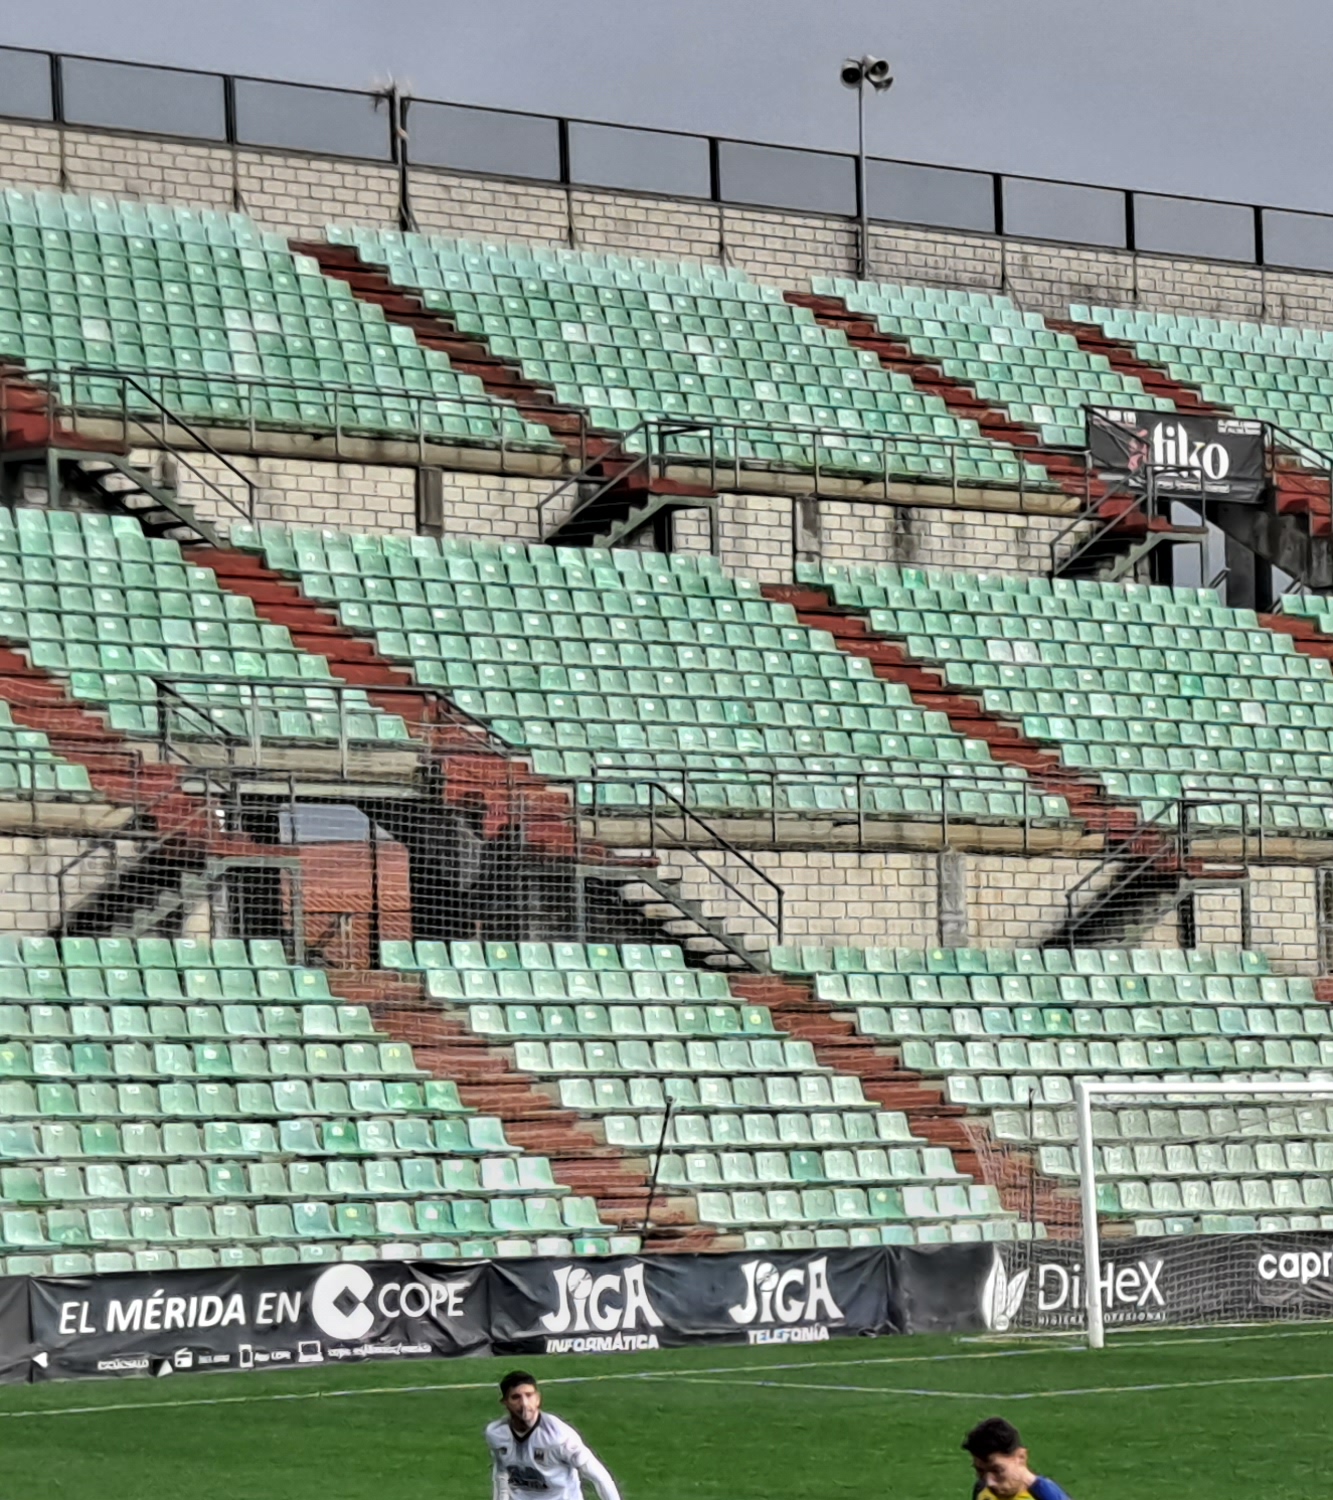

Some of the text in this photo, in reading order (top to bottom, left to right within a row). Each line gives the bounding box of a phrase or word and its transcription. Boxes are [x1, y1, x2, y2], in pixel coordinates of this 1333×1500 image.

[58, 1282, 473, 1336] EL MÉRIDA EN COPE
[546, 1332, 660, 1354] INFORMÁTICA
[748, 1324, 831, 1345] TELEFONÍA
